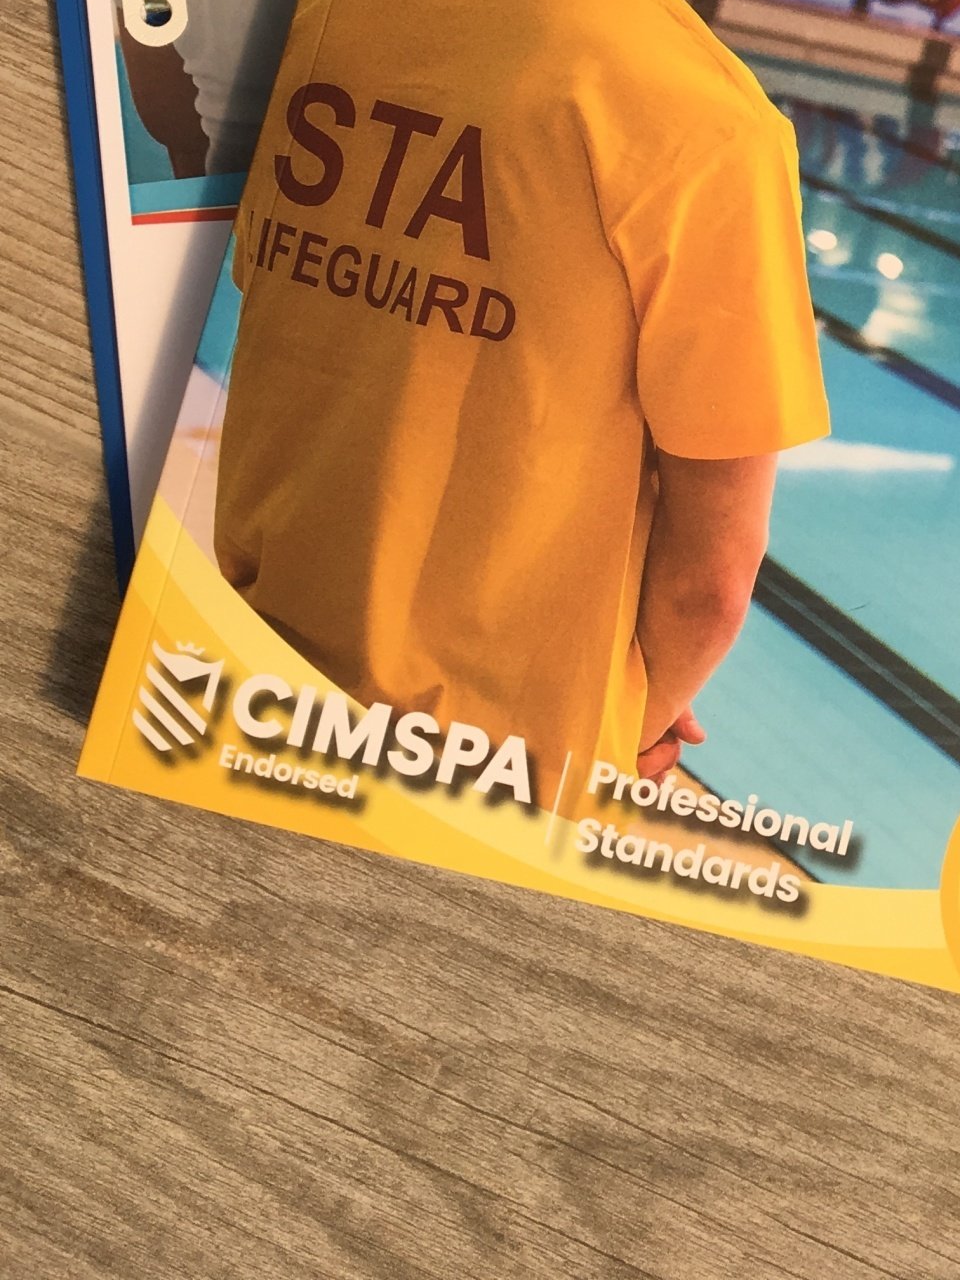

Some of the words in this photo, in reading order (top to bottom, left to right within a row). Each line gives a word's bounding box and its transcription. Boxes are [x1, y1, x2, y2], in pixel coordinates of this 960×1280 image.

[273, 82, 491, 262] STA
[218, 744, 359, 801] Endorsed
[232, 673, 533, 804] CIMSPA
[587, 761, 855, 857] Professional
[573, 818, 801, 904] Standards
